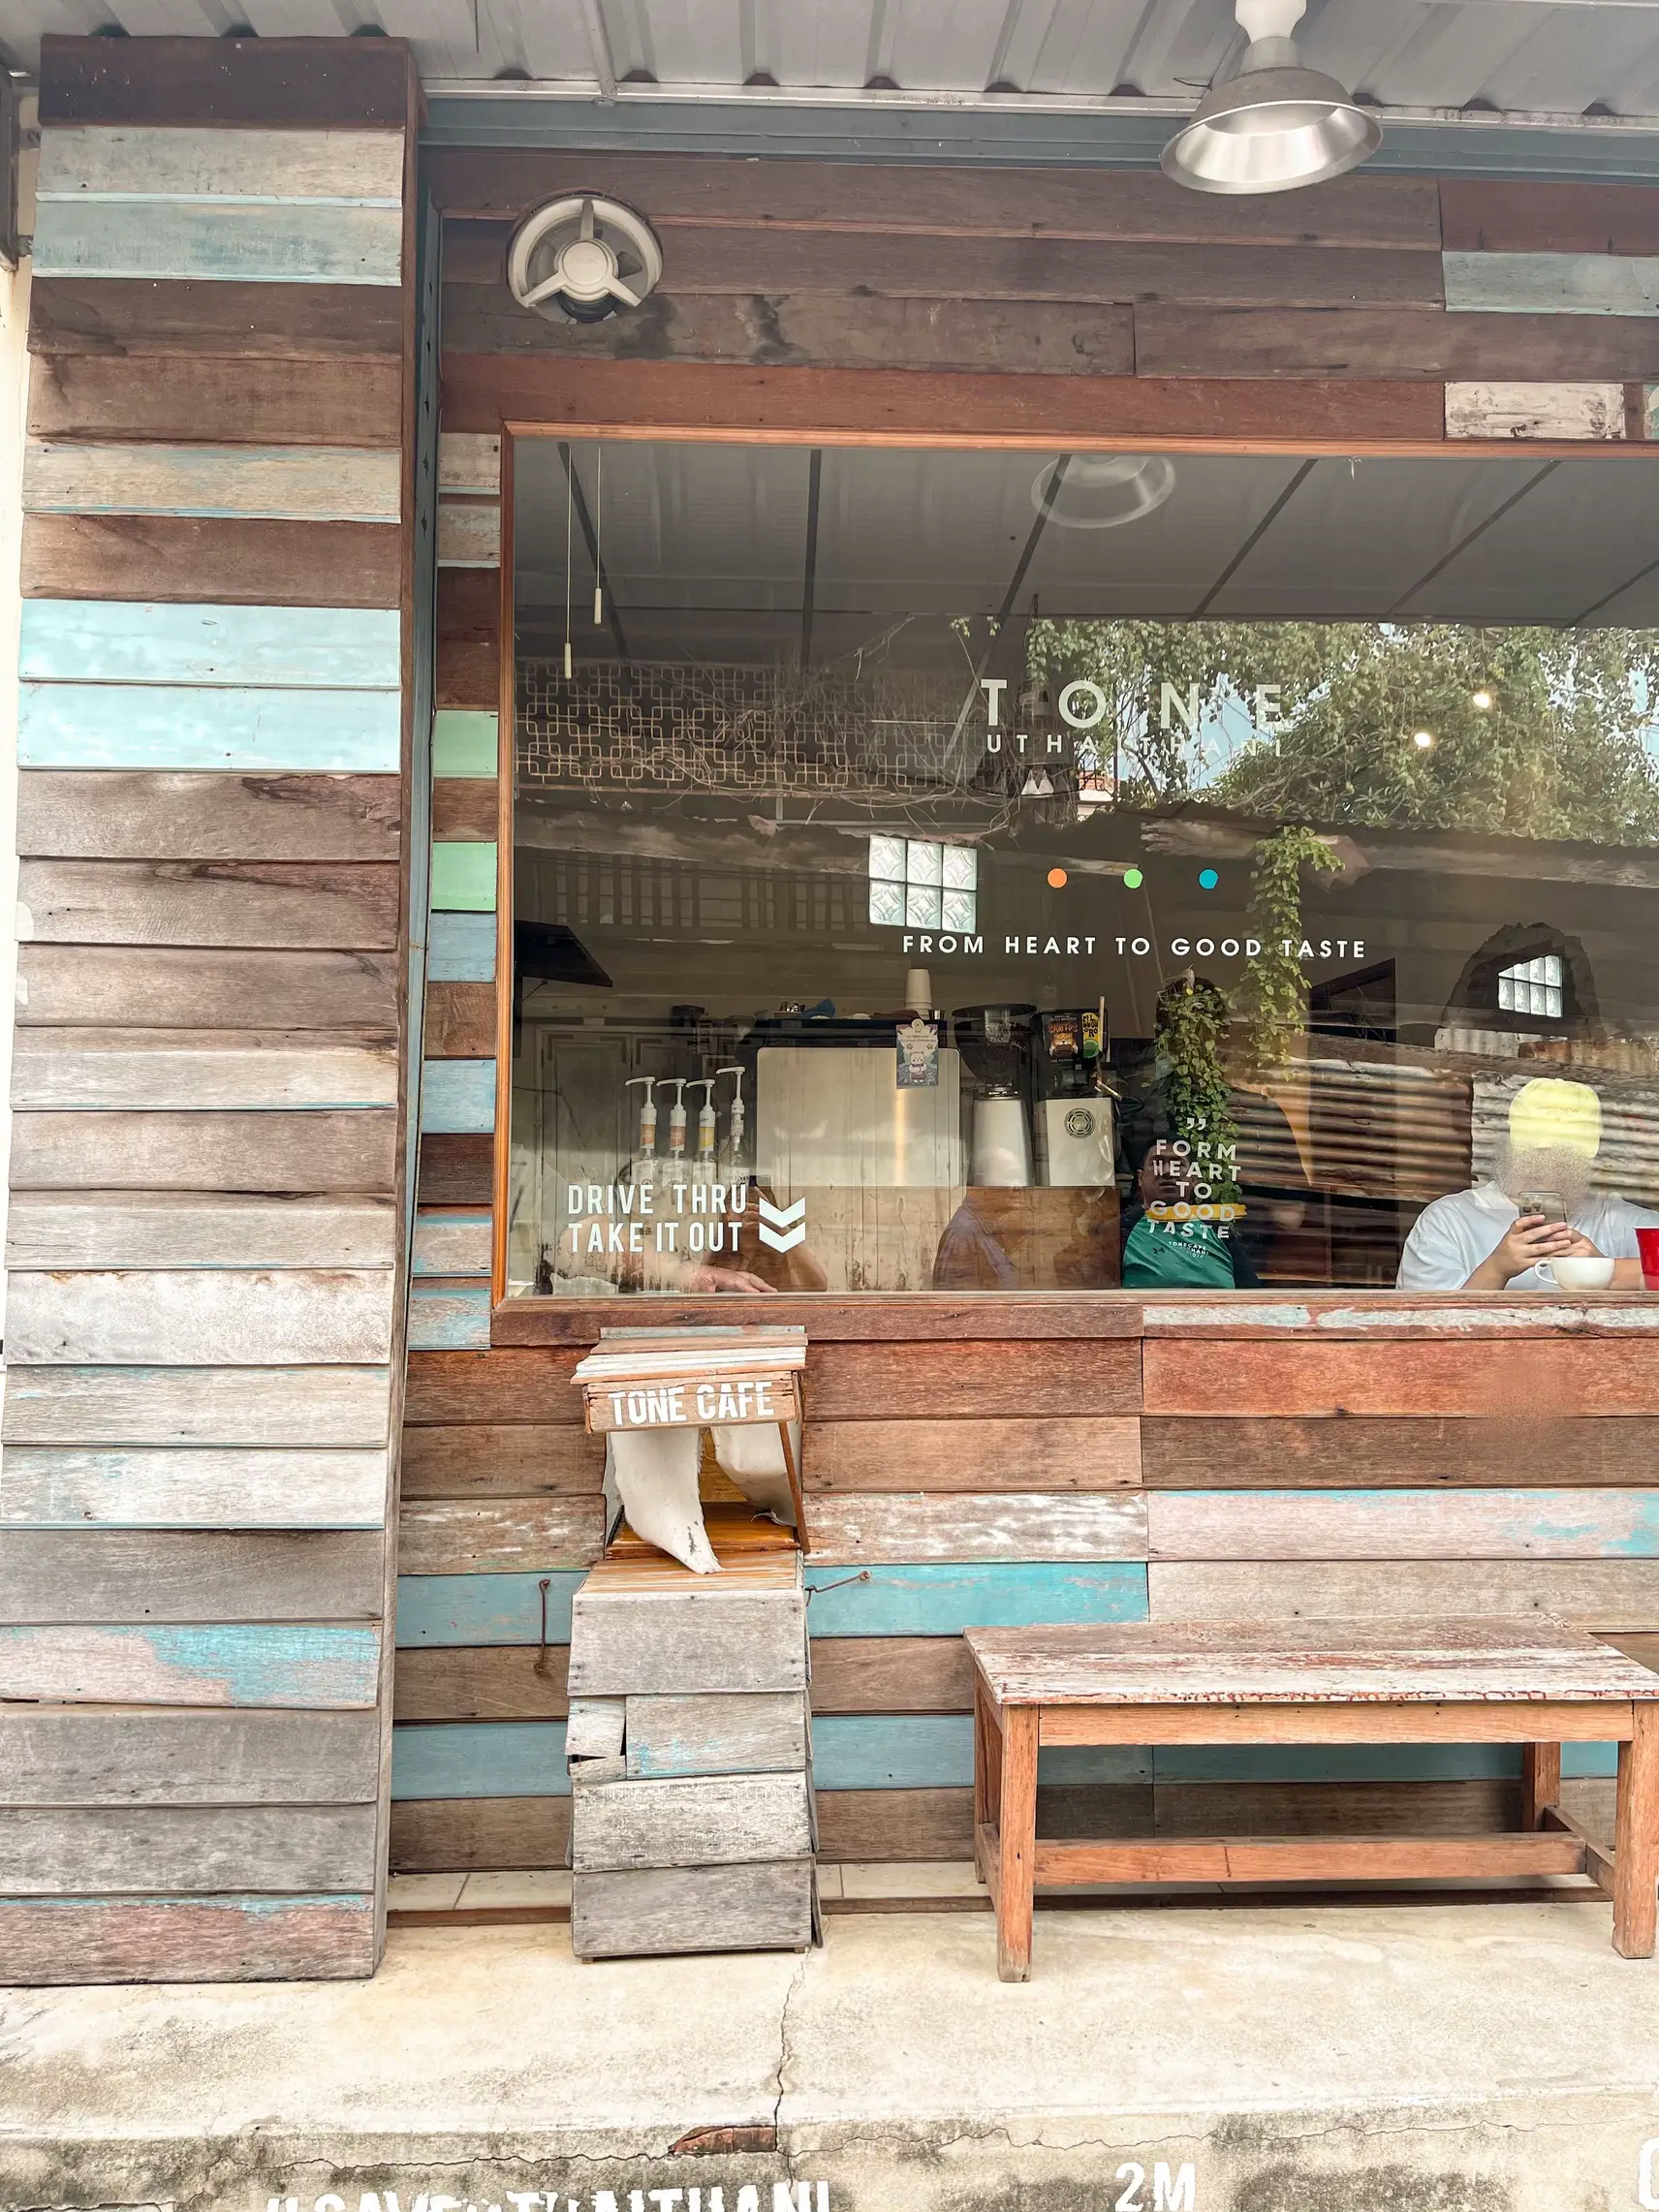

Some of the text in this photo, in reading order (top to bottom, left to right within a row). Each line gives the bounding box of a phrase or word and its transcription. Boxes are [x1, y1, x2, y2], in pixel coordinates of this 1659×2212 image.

[980, 678, 1282, 730] TONE
[902, 935, 1365, 958] FROM HEART TO GOOD TASTE
[1156, 1139, 1236, 1161] FORM
[1153, 1160, 1241, 1182] HEART
[568, 1184, 746, 1214] DRIVE THRU
[1175, 1181, 1212, 1199] TO
[1150, 1199, 1236, 1222] GOOD
[568, 1222, 743, 1253] TAKE IT OUT
[1146, 1219, 1230, 1239] TASTE
[608, 1381, 774, 1425] TONE CAFE
[1114, 2162, 1196, 2212] 2M
